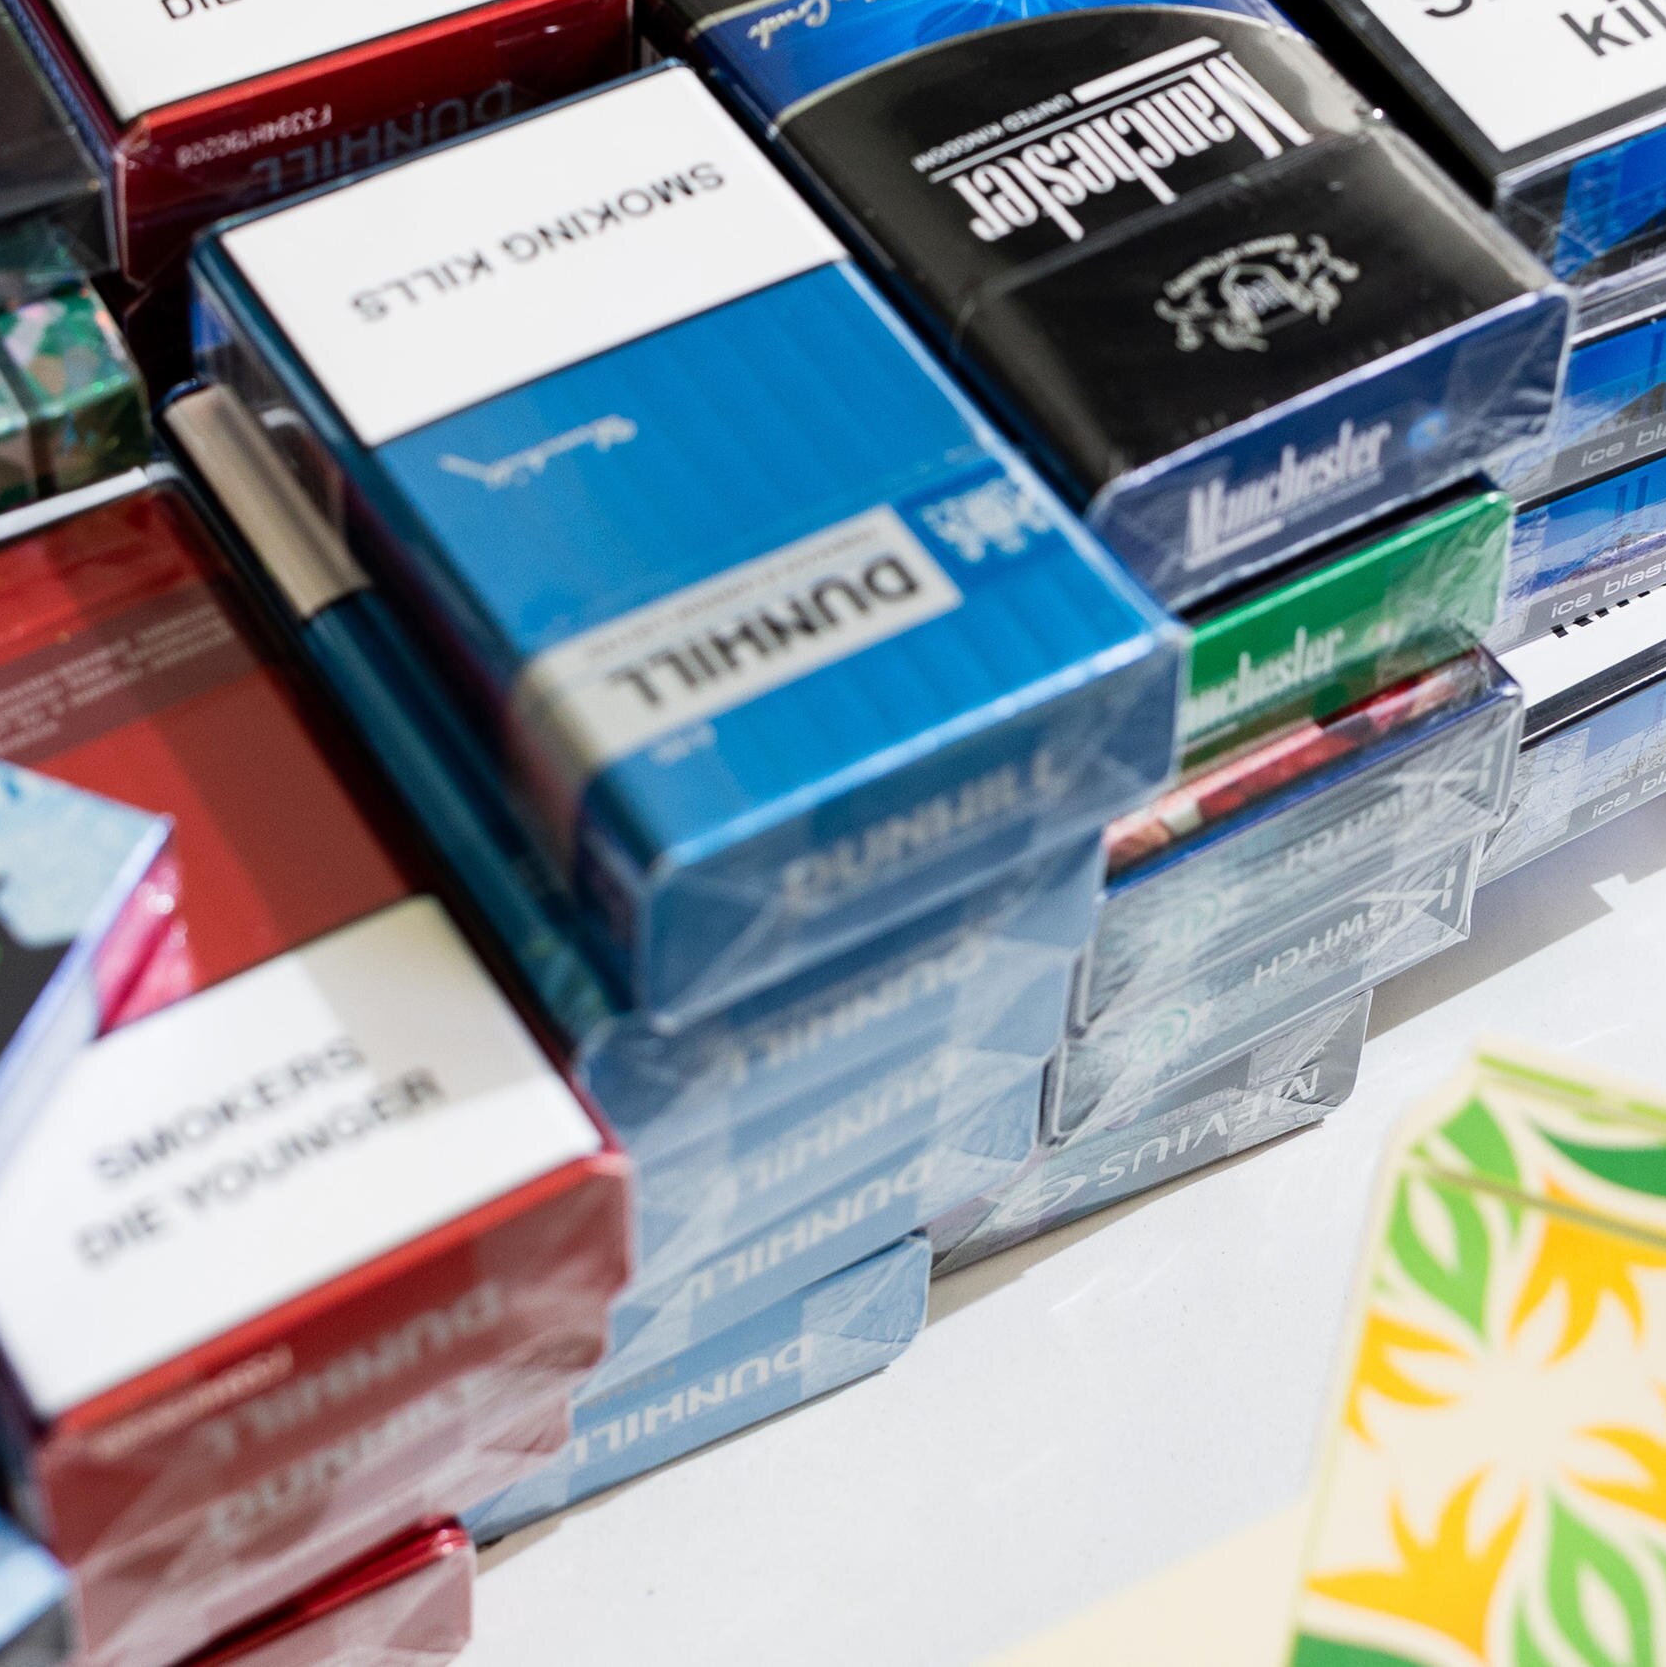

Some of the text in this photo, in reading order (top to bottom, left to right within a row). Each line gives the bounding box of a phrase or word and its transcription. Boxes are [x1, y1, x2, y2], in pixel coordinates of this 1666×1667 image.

[251, 77, 517, 190] DUNHILL
[911, 91, 1075, 173] UNITED KINGDOM
[952, 50, 1314, 242] Manchester
[349, 161, 727, 325] SMOKING KILLS
[1181, 416, 1393, 572] Manchester
[1579, 440, 1626, 468] ice
[602, 552, 923, 712] DUNHILL
[1550, 592, 1592, 620] ice
[1590, 790, 1631, 820] ice
[1253, 900, 1393, 988] SWITCH
[73, 1066, 450, 1270] DIE YOUNGER
[95, 1035, 366, 1184] SMOKERS
